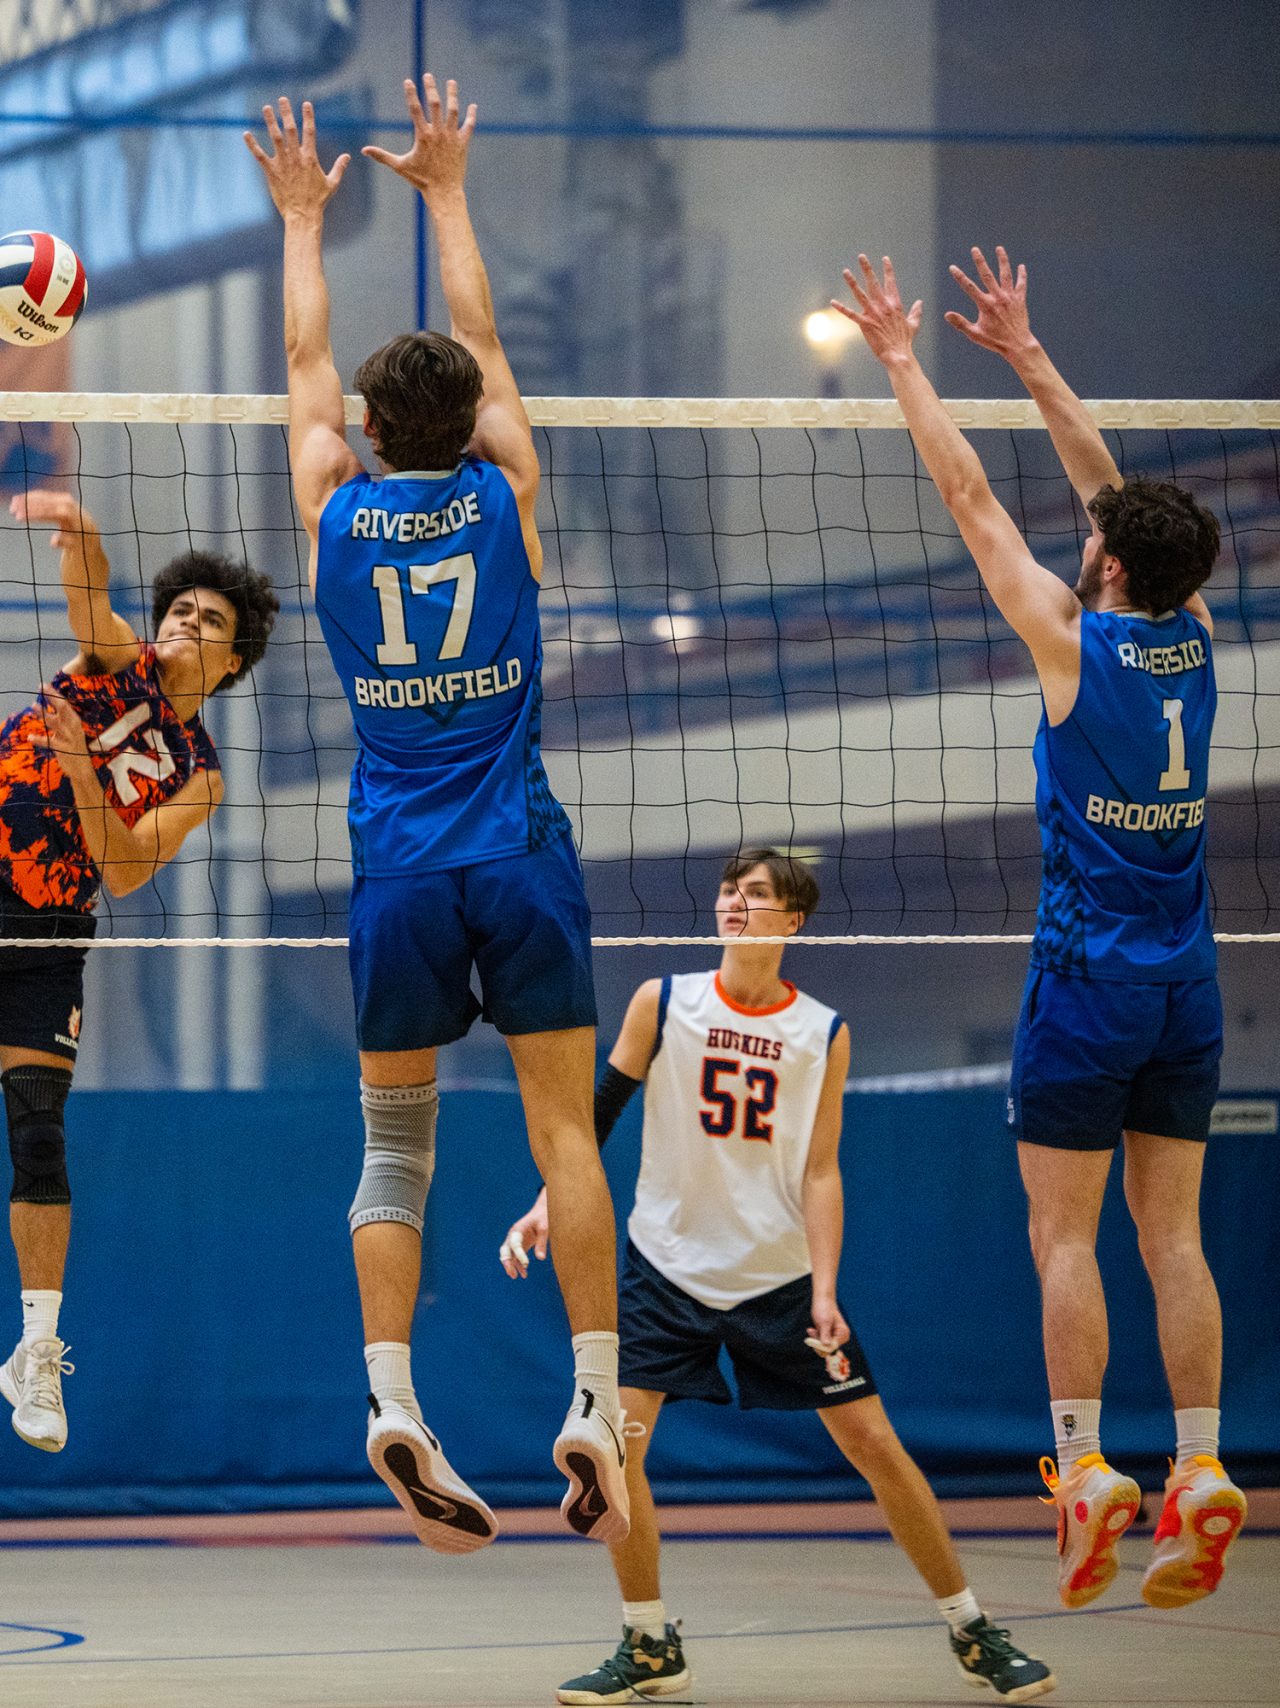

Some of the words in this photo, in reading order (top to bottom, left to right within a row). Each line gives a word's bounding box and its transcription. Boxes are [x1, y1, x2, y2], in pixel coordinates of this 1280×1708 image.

[17, 299, 60, 334] Wilson
[351, 491, 482, 544] RIVERSIDE
[372, 551, 478, 667] 17
[354, 656, 523, 709] BROOKFIELD
[87, 700, 177, 807] 12
[1157, 697, 1191, 792] 1
[706, 1027, 784, 1062] HUSKIES
[698, 1055, 780, 1144] 52
